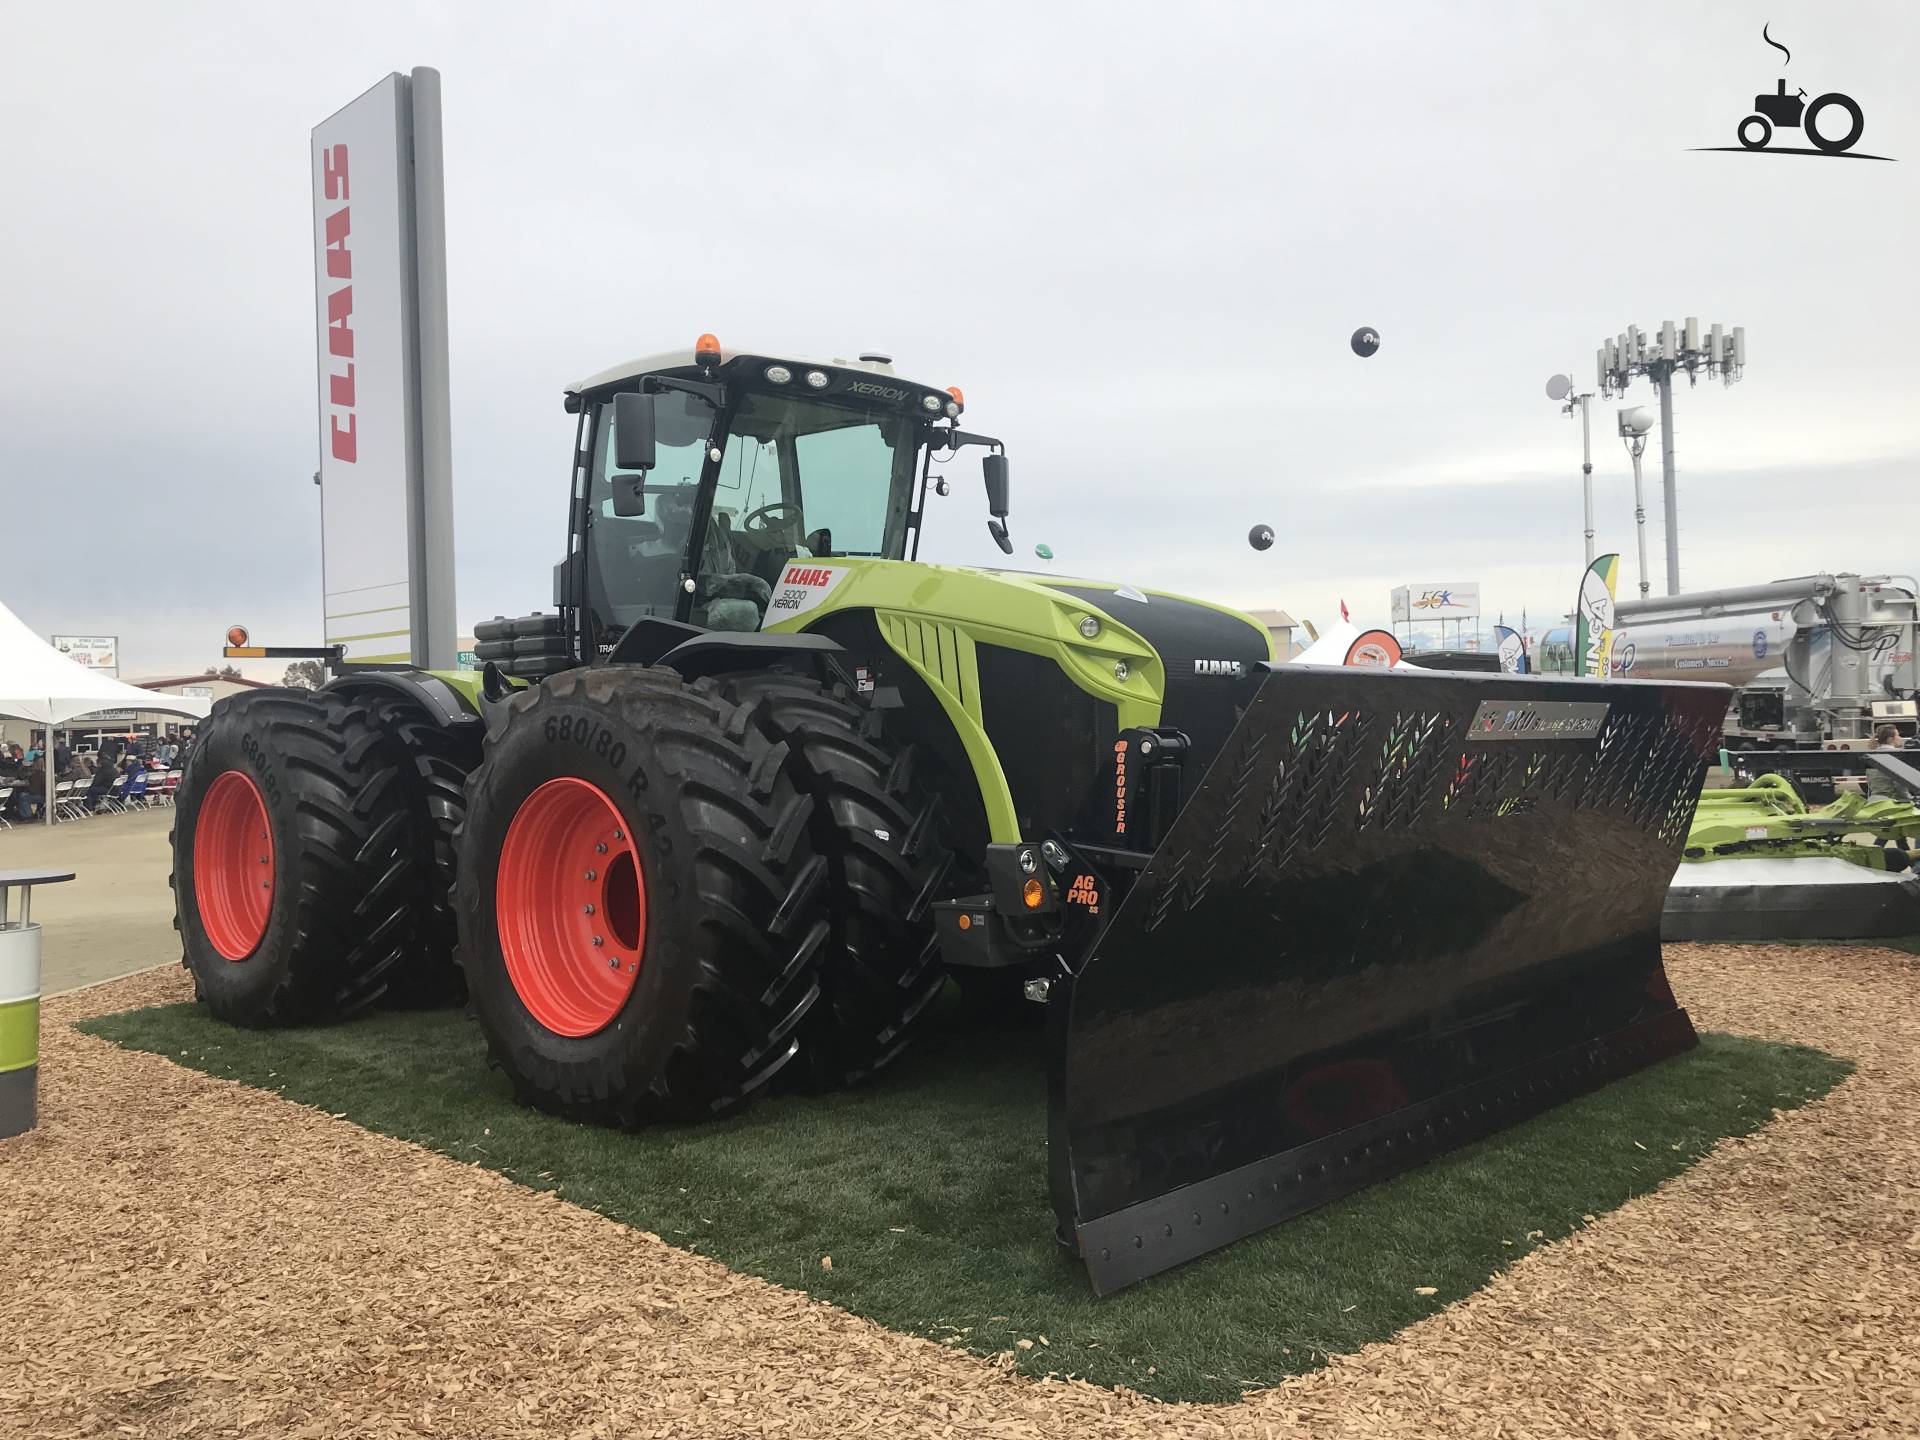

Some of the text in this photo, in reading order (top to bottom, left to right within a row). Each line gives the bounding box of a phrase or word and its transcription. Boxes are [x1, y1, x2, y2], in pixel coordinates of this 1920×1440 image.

[323, 143, 357, 464] CLAAS
[847, 381, 909, 401] XERION
[784, 568, 832, 587] CLAAS
[772, 599, 800, 610] XERION
[782, 590, 807, 600] 5000
[1194, 659, 1241, 675] CLAAS
[544, 715, 626, 769] 680/80
[627, 766, 649, 800] R
[241, 733, 281, 807] 680/80
[1116, 752, 1126, 833] GROUSER
[1072, 875, 1095, 890] AG
[1067, 889, 1099, 905] PRO
